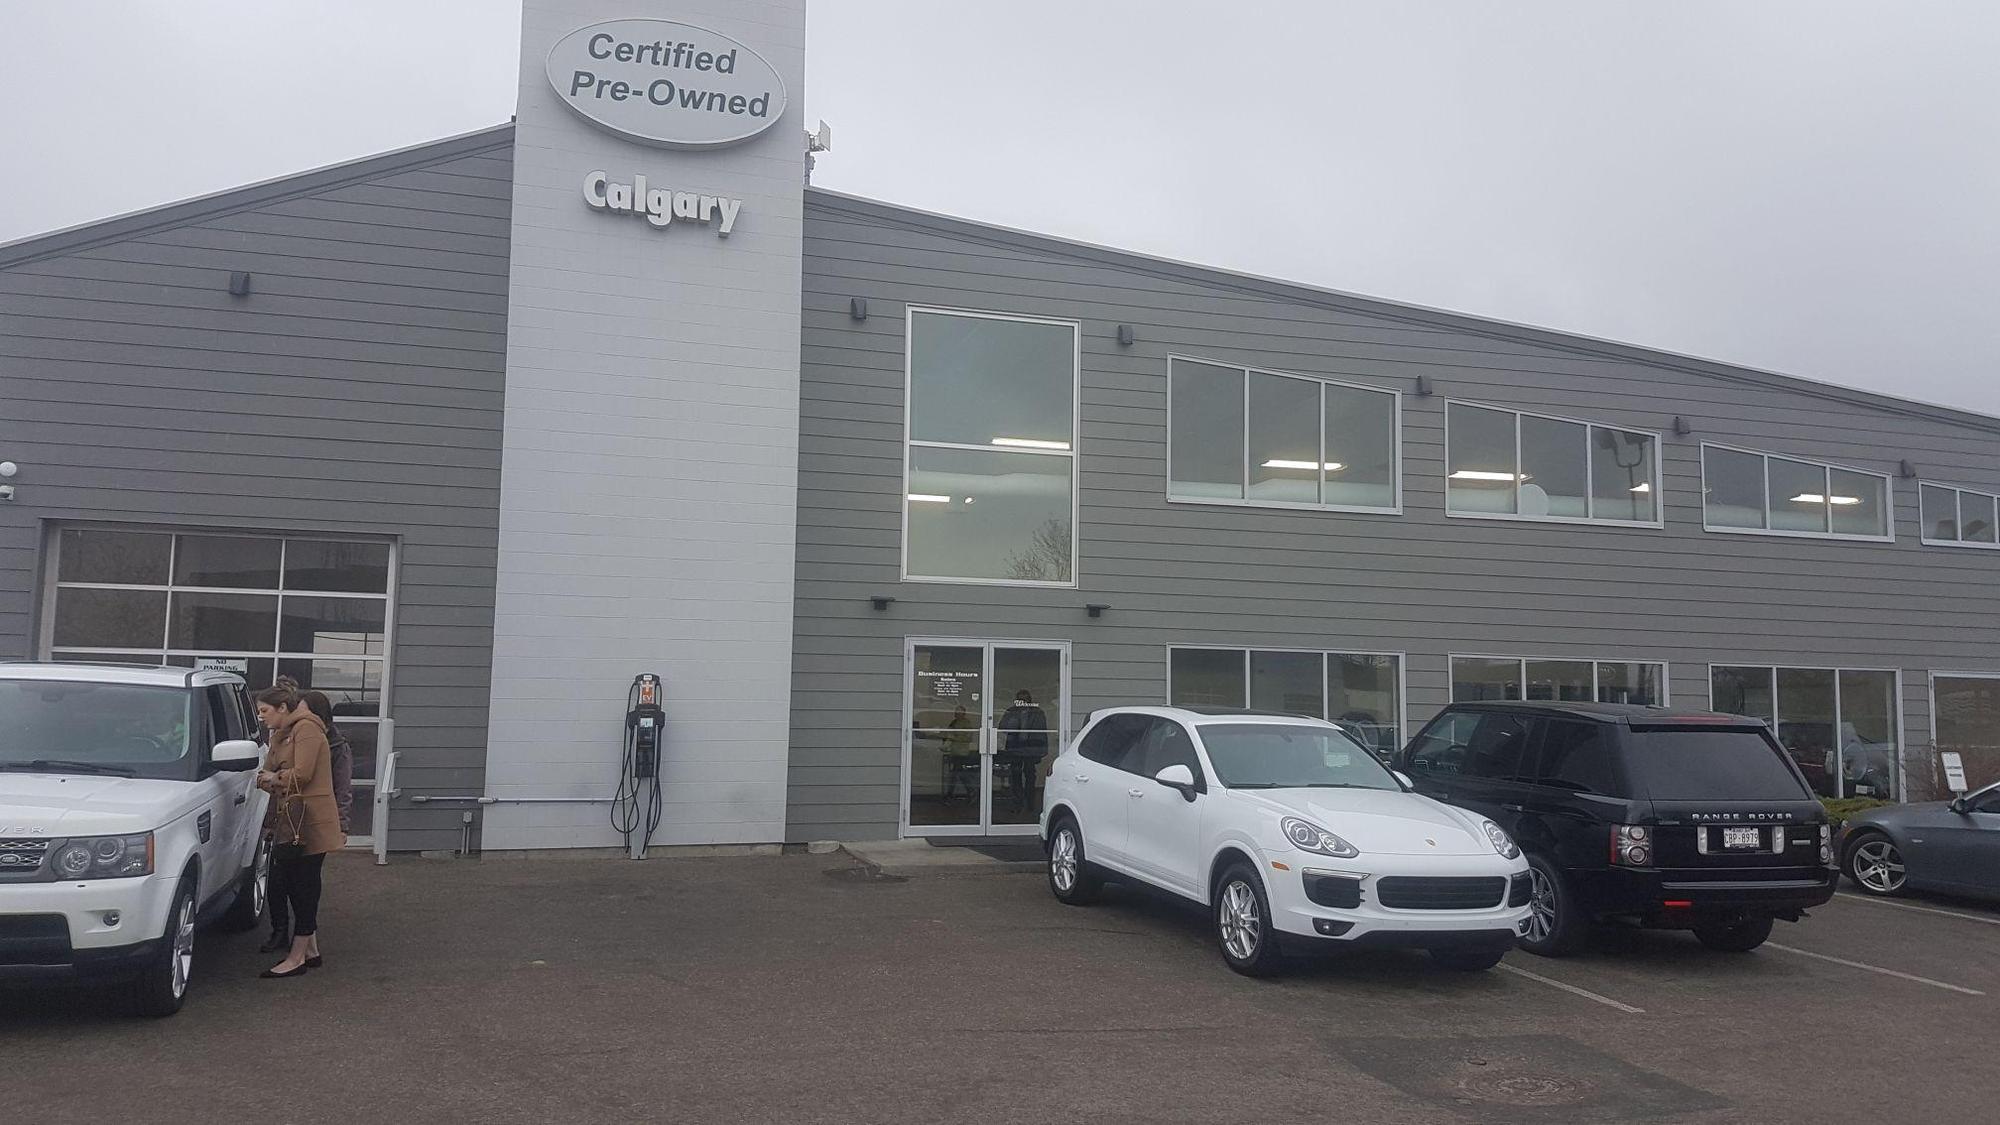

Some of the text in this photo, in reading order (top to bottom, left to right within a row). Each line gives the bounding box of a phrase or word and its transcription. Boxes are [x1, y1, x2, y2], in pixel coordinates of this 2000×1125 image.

[588, 33, 737, 75] Certified
[570, 70, 770, 118] Pre-Owned
[583, 169, 742, 237] Calgary
